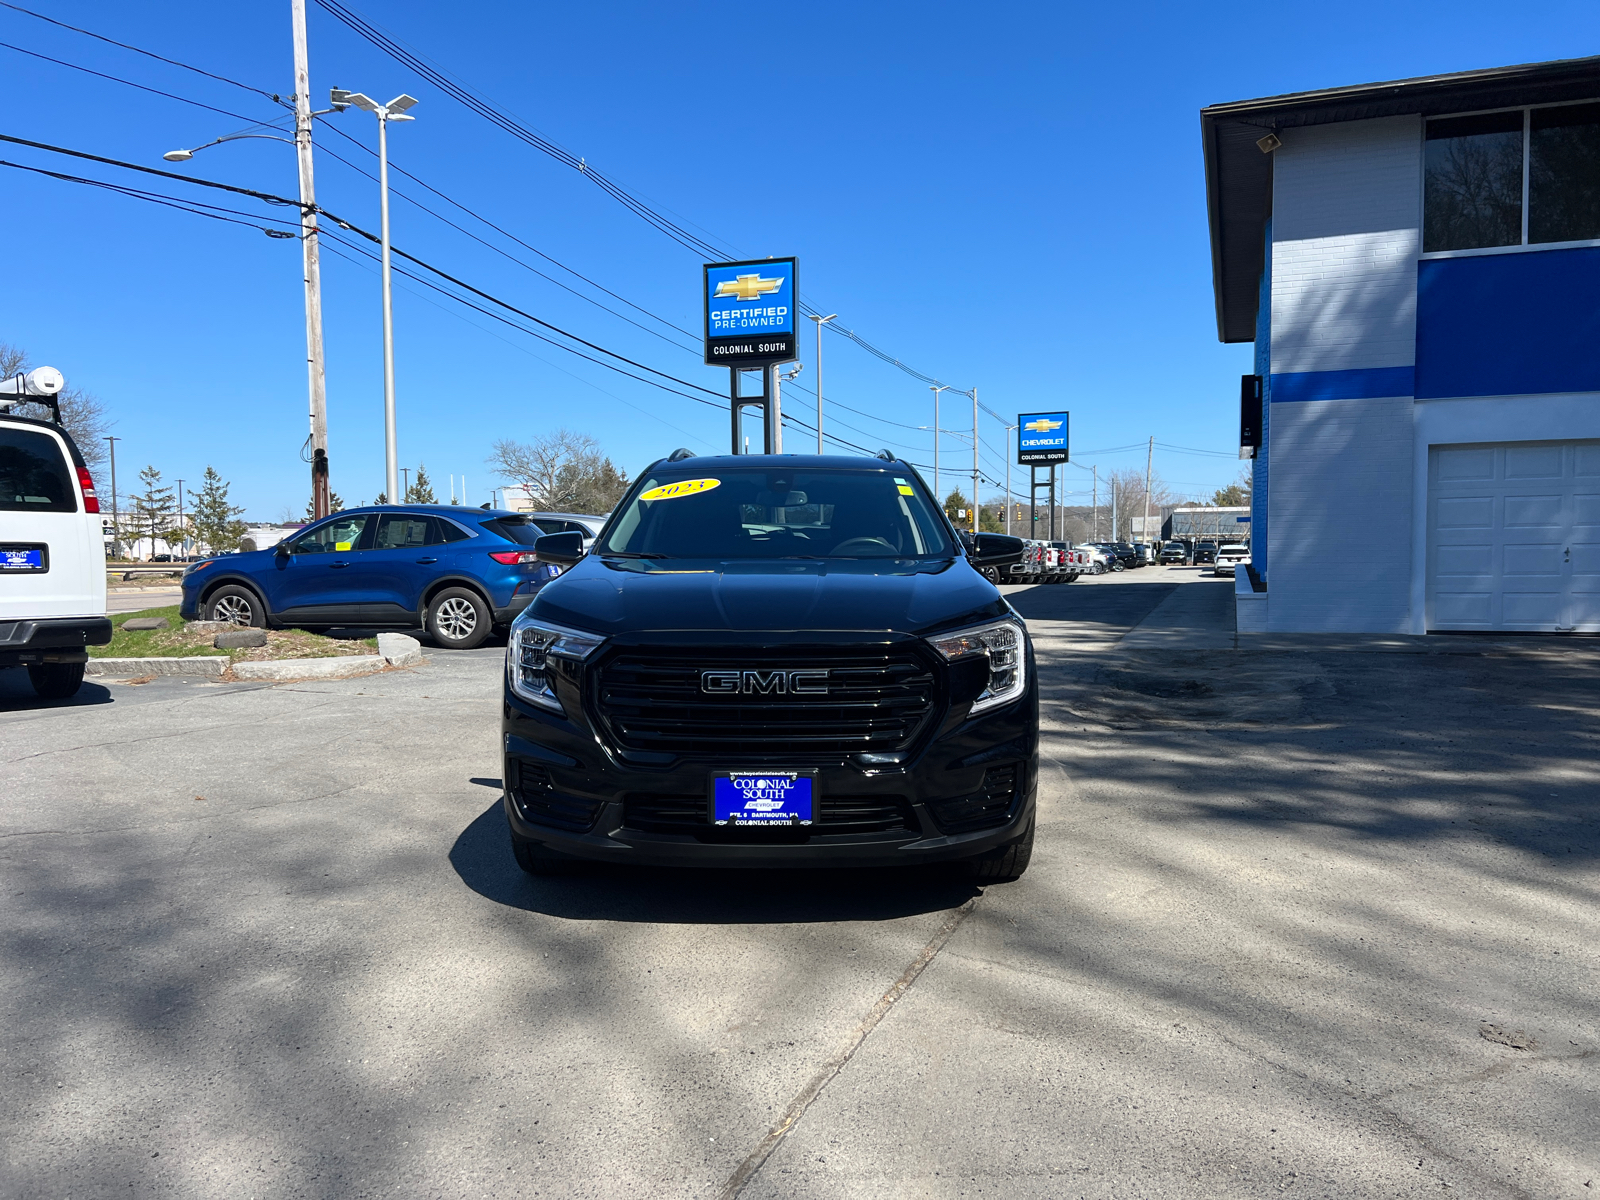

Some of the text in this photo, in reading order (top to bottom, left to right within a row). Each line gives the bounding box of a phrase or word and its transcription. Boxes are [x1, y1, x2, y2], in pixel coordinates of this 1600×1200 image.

[711, 306, 787, 320] CERTIFIED
[715, 316, 784, 329] PRE-OWNED
[714, 342, 786, 354] COLONIAL SOUTH
[1022, 438, 1064, 446] CHEVROLET
[654, 481, 704, 498] 2023
[701, 671, 829, 694] GMC
[734, 779, 794, 789] COLONIAL
[742, 789, 785, 798] SOUTH
